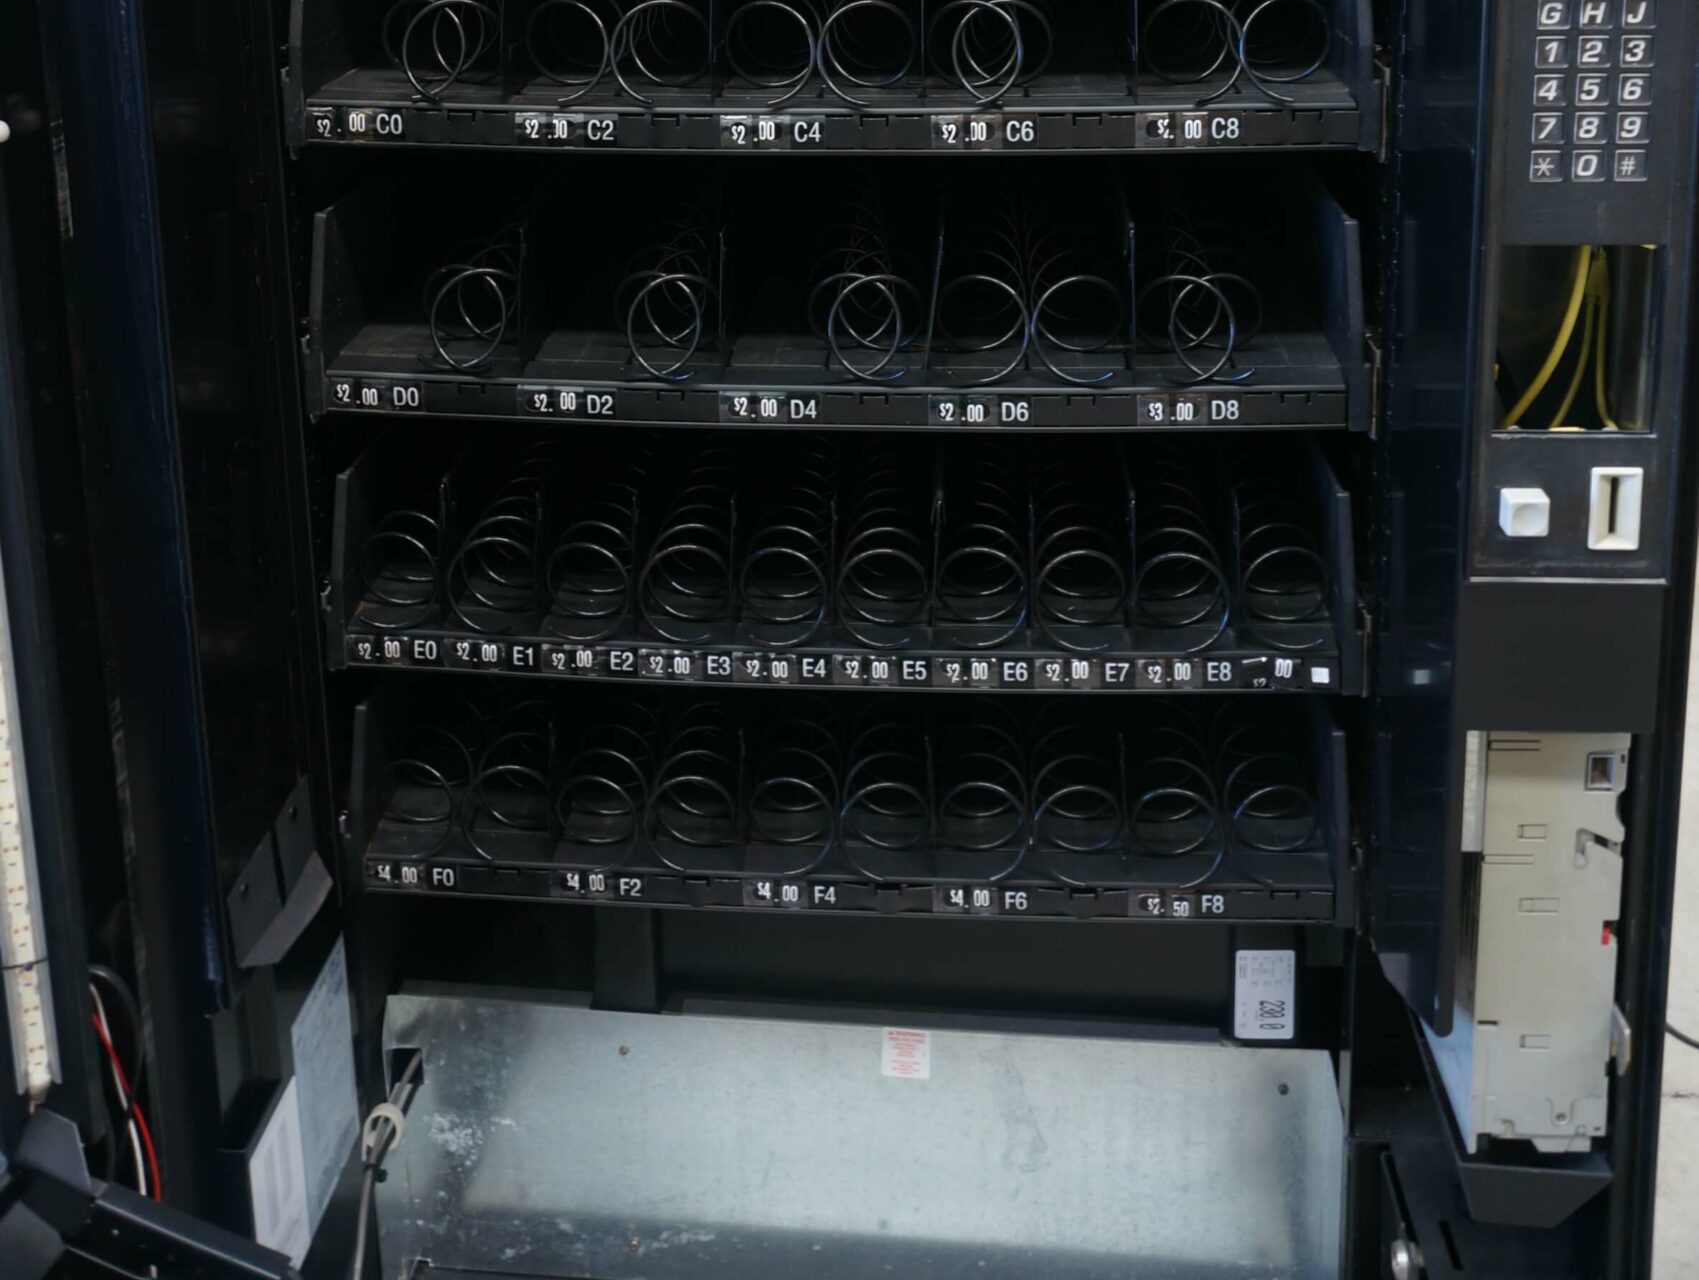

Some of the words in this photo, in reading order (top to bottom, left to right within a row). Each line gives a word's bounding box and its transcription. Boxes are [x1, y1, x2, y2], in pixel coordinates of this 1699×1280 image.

[1540, 2, 1563, 24] G
[1583, 2, 1606, 23] H
[1626, 1, 1647, 23] J
[1544, 41, 1559, 63] 1
[1581, 40, 1603, 62] 2
[1624, 40, 1646, 62] 3
[1538, 79, 1558, 101] 4
[1580, 79, 1601, 100] 5
[1622, 78, 1644, 100] 6
[376, 113, 403, 135] C0
[587, 119, 615, 141] C2
[794, 121, 821, 143] C4
[1006, 120, 1034, 142] C6
[1211, 117, 1239, 139] C8
[1538, 117, 1557, 139] 7
[1578, 116, 1599, 139] 8
[1620, 116, 1642, 138] 9
[1576, 154, 1598, 176] 0
[1620, 156, 1636, 176] #
[393, 386, 419, 407] D0
[586, 394, 614, 415] D2
[790, 399, 817, 419] D4
[1001, 401, 1030, 422] D6
[1211, 399, 1239, 420] D8
[414, 639, 437, 660] E0
[513, 646, 534, 666] E1
[609, 650, 634, 671] E2
[707, 655, 731, 675] E3
[802, 658, 827, 678] E4
[903, 660, 927, 680] E5
[1003, 662, 1028, 682] E6
[1105, 662, 1130, 682] E7
[1207, 661, 1232, 682] E8
[432, 868, 455, 887] F0
[620, 878, 642, 897] F2
[814, 885, 836, 904] F4
[1004, 891, 1028, 910] F6
[1201, 894, 1225, 914] F8
